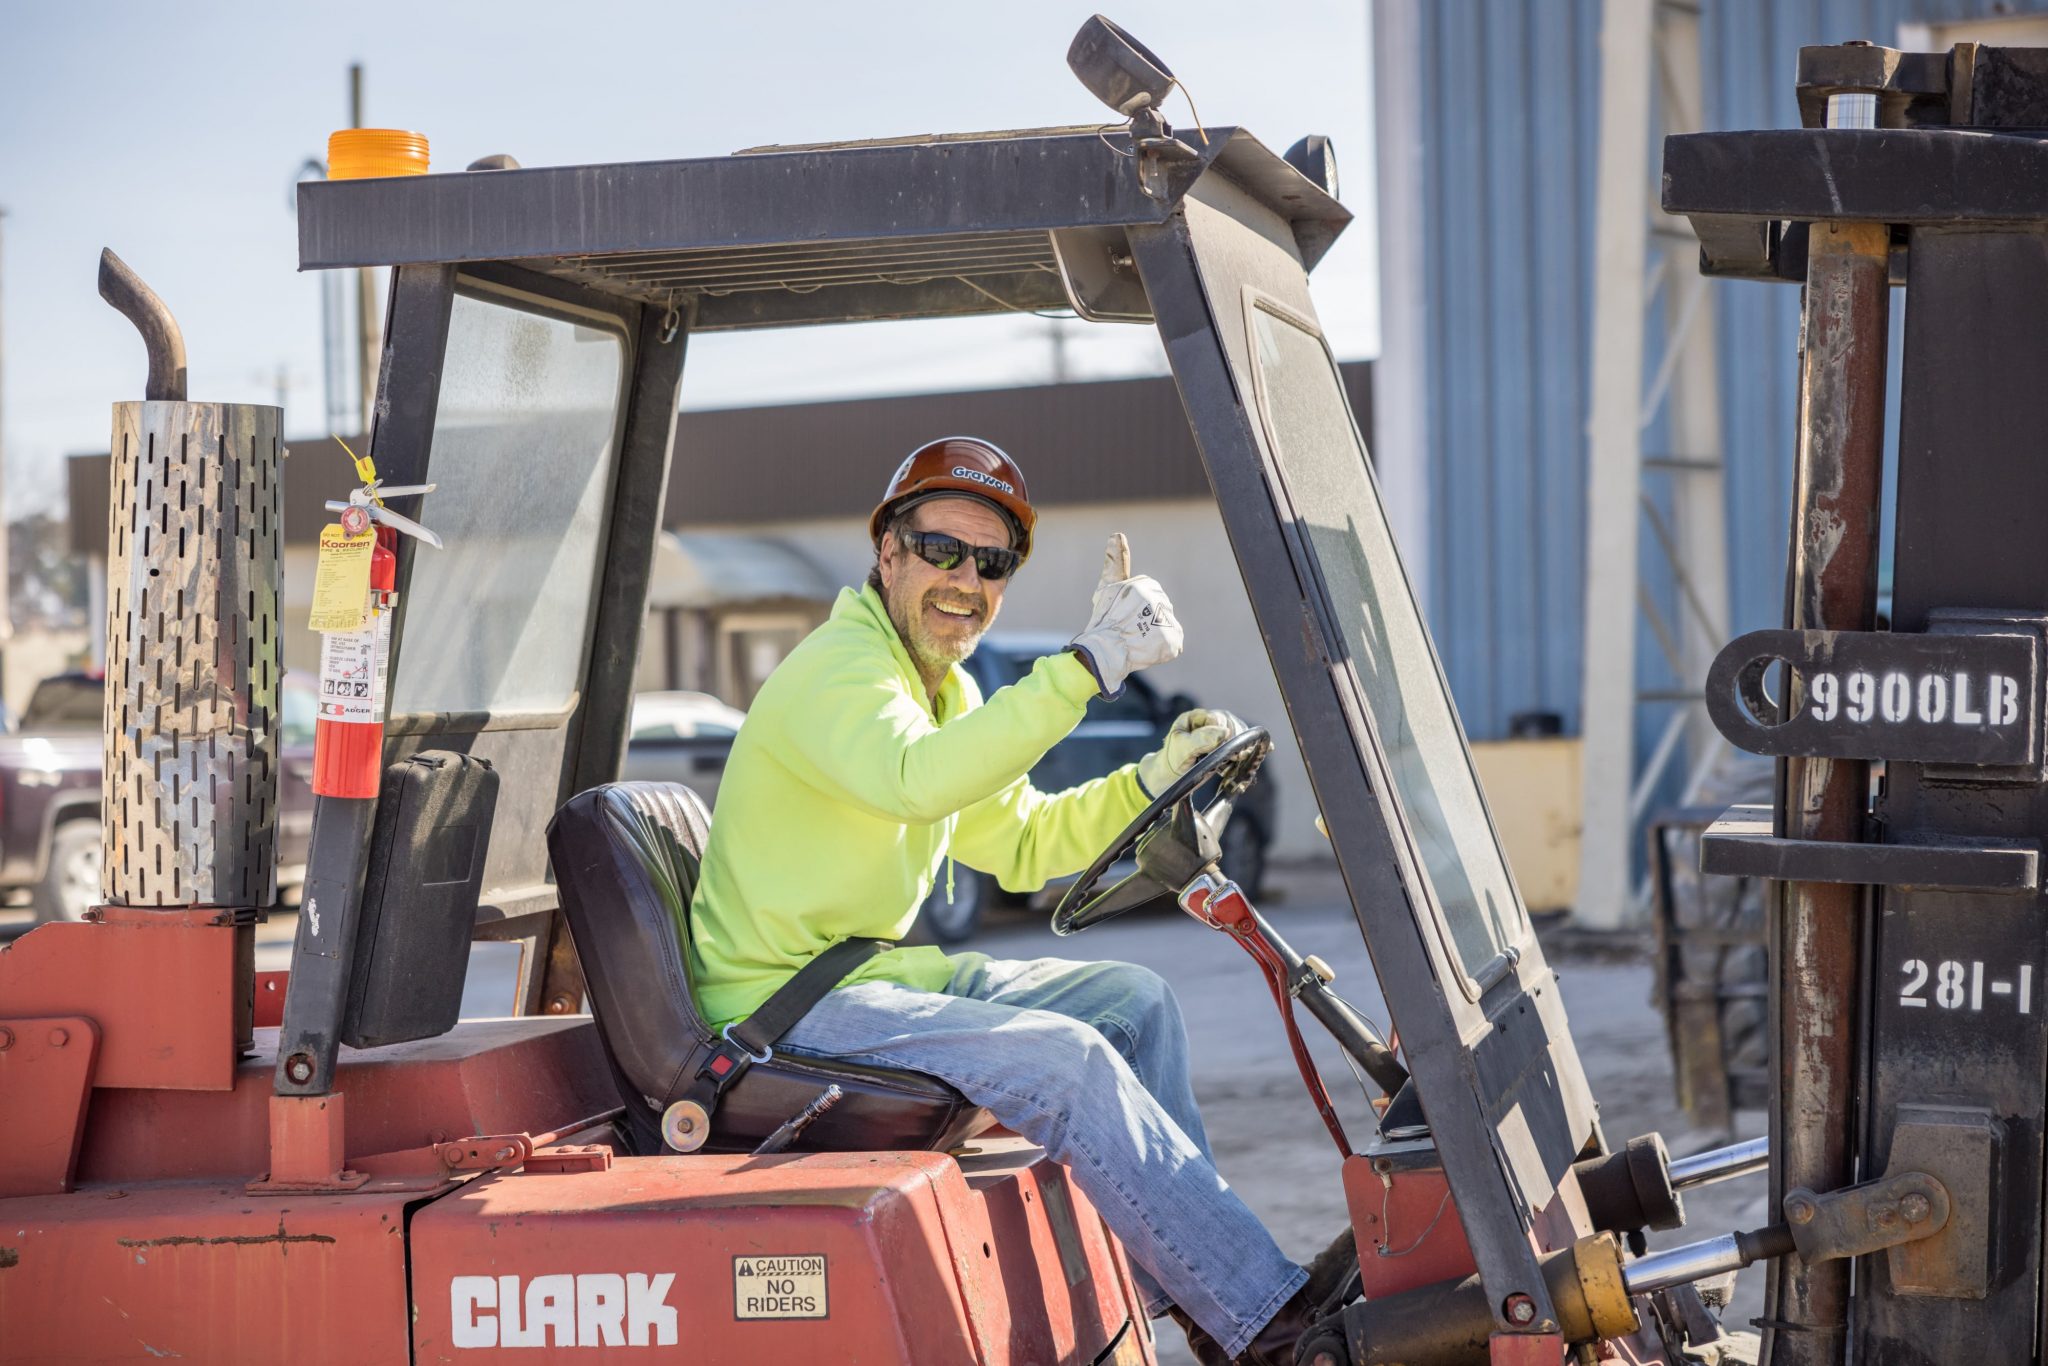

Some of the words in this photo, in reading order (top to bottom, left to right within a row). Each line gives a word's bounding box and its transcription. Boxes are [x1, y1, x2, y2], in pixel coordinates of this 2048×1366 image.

[321, 539, 370, 548] Koorsen
[1810, 671, 2019, 725] 9900LB
[1899, 958, 2032, 1014] 281-1
[756, 1258, 822, 1272] CAUTION
[767, 1279, 795, 1295] NO
[450, 1272, 678, 1348] CLARK
[747, 1296, 816, 1312] RIDERS
